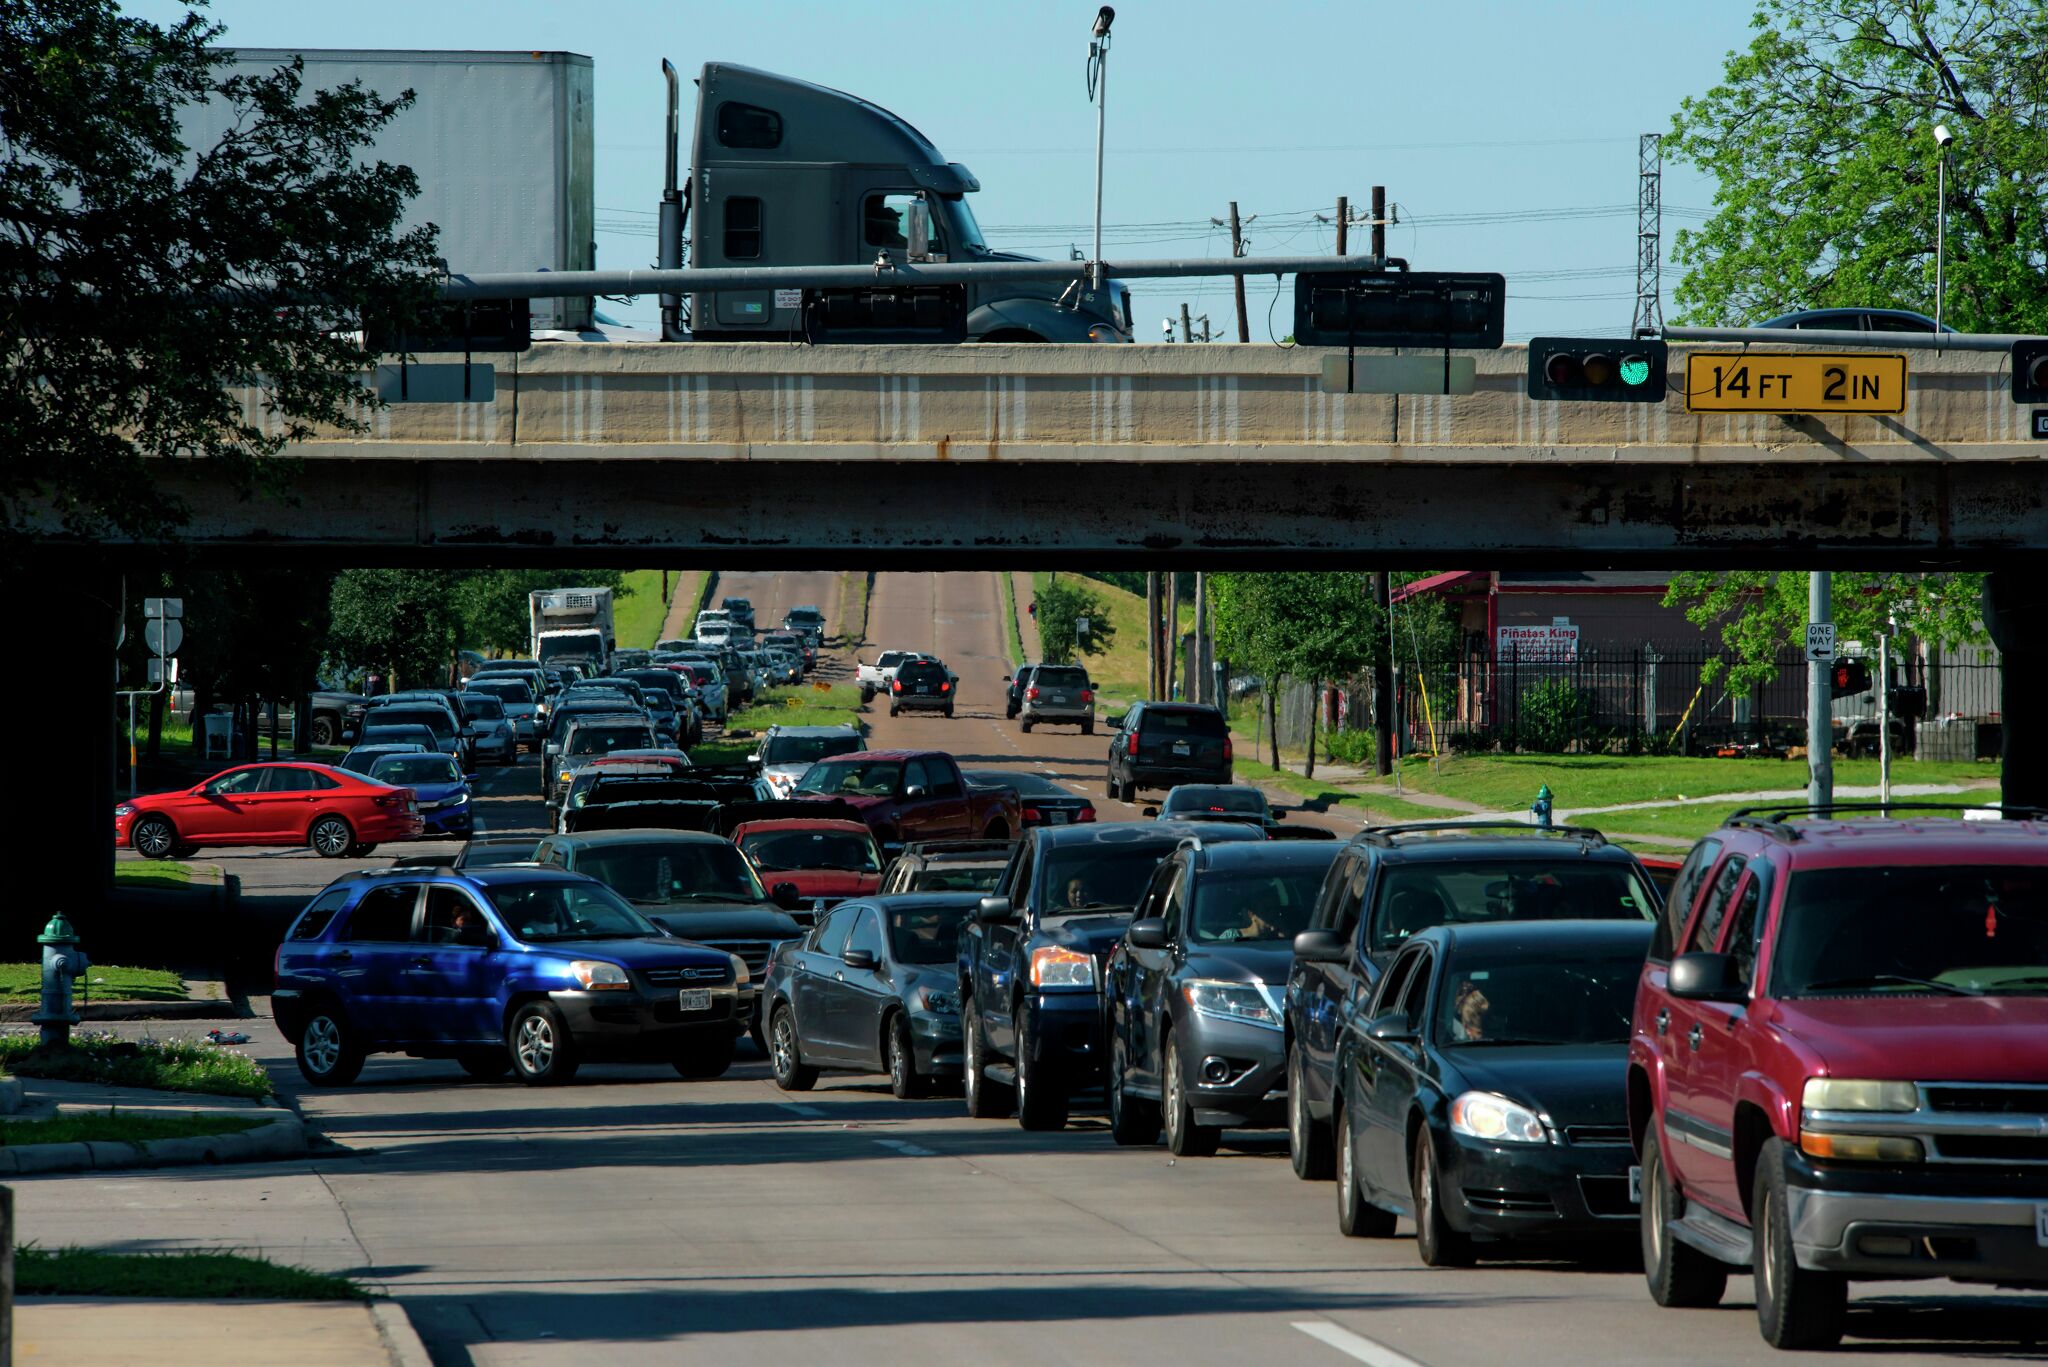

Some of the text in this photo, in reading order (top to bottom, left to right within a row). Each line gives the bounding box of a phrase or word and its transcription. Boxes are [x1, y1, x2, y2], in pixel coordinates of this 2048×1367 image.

[1713, 366, 1879, 401] 14 FT 2 IN
[1501, 628, 1577, 640] Piñatas King
[1810, 626, 1831, 635] ONE
[1809, 636, 1831, 645] WAY
